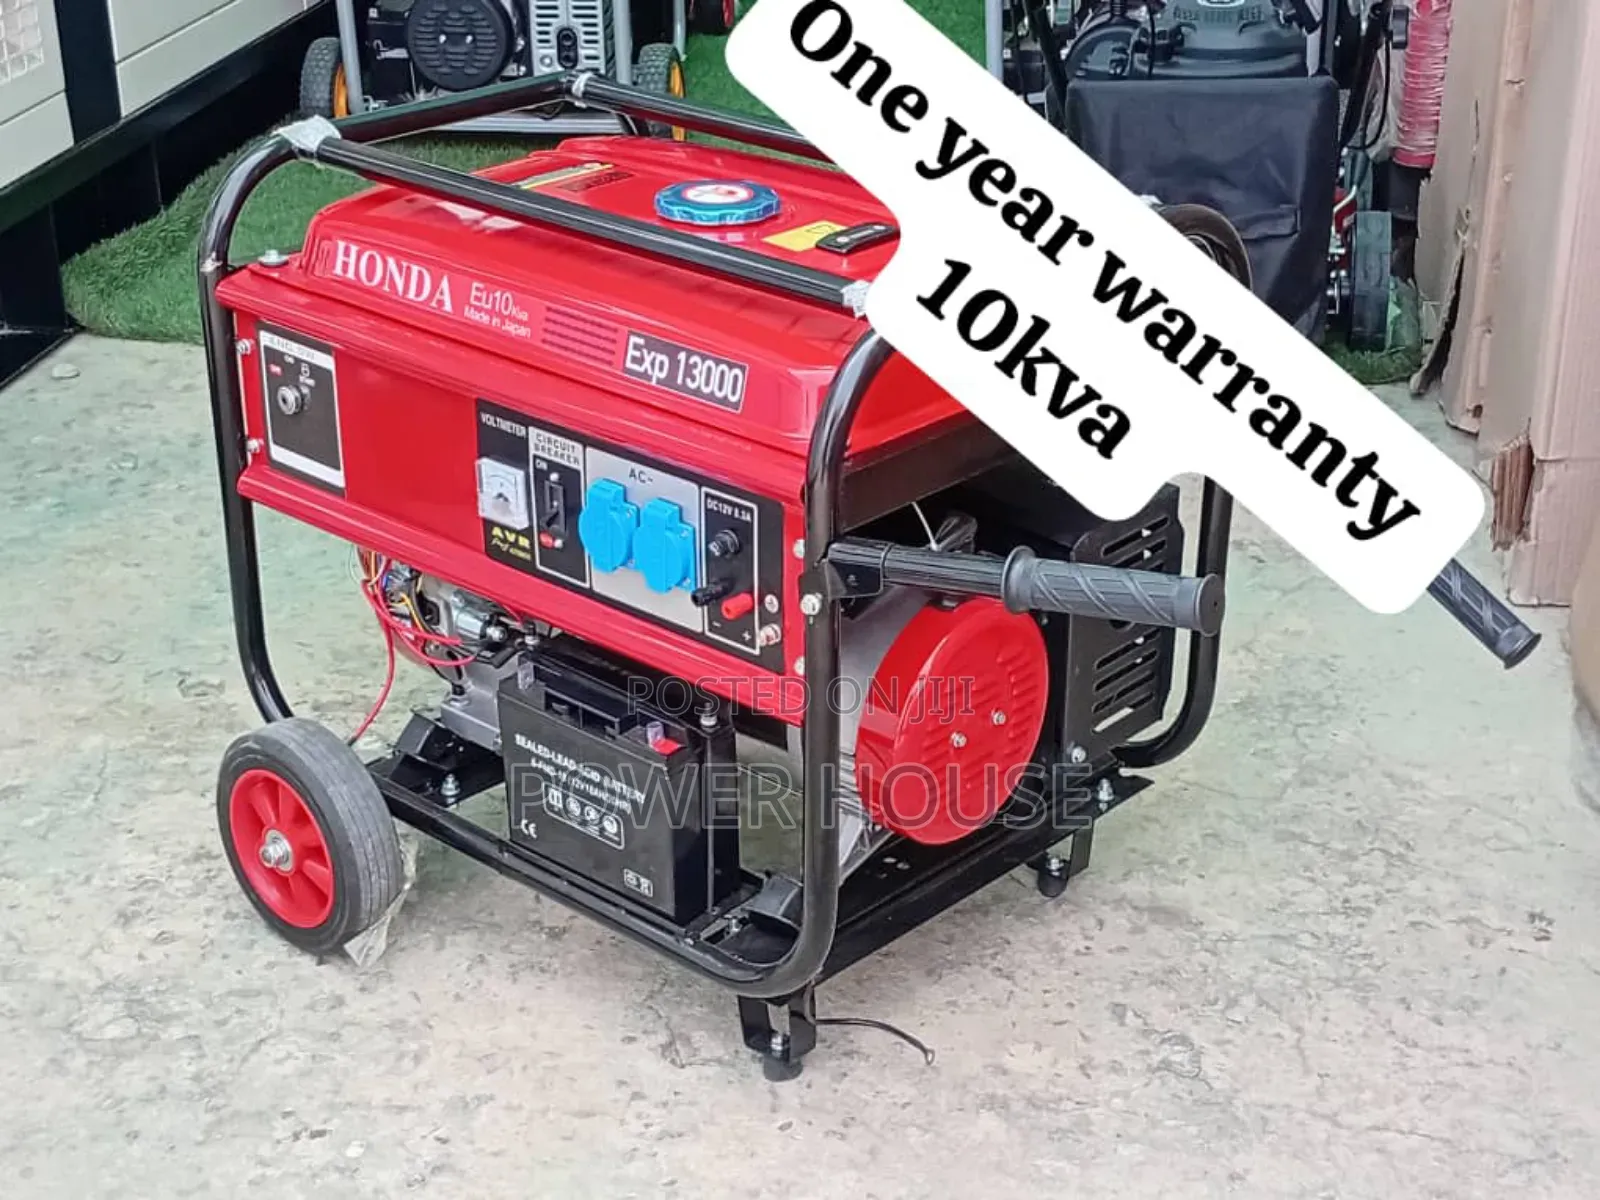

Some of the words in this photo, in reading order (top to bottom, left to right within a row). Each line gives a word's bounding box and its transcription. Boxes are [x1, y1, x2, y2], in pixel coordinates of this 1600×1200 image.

[333, 239, 454, 313] HONDA
[463, 304, 491, 325] Made
[501, 319, 531, 339] Japan
[625, 335, 670, 386] Exp
[676, 350, 743, 403] 13000
[480, 411, 527, 438] VOLTMETER
[533, 442, 581, 466] BREAKER
[535, 432, 576, 453] CIRCUIT
